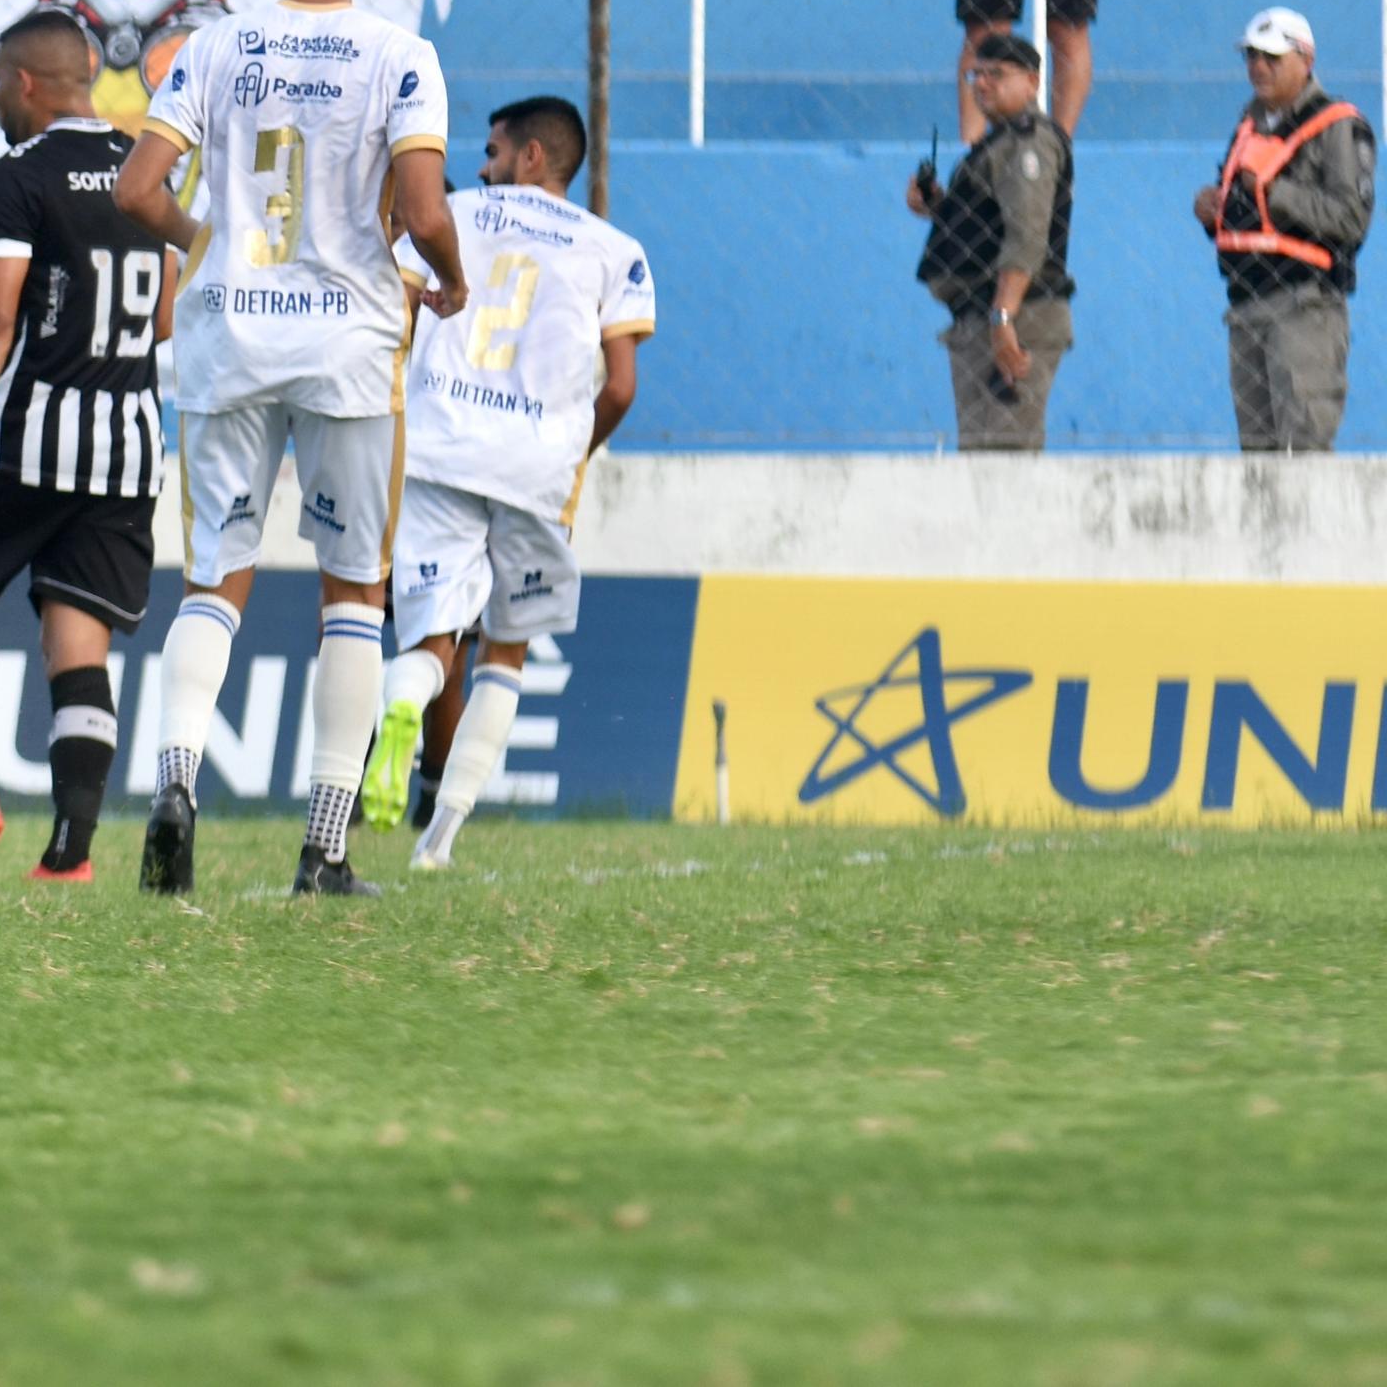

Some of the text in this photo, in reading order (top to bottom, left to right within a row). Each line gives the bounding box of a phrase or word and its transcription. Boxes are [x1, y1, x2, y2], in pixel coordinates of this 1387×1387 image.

[67, 165, 120, 192] sorri
[245, 124, 304, 268] 3
[90, 248, 161, 358] 19
[234, 288, 349, 315] DETRAN-PB
[468, 252, 539, 371] 2
